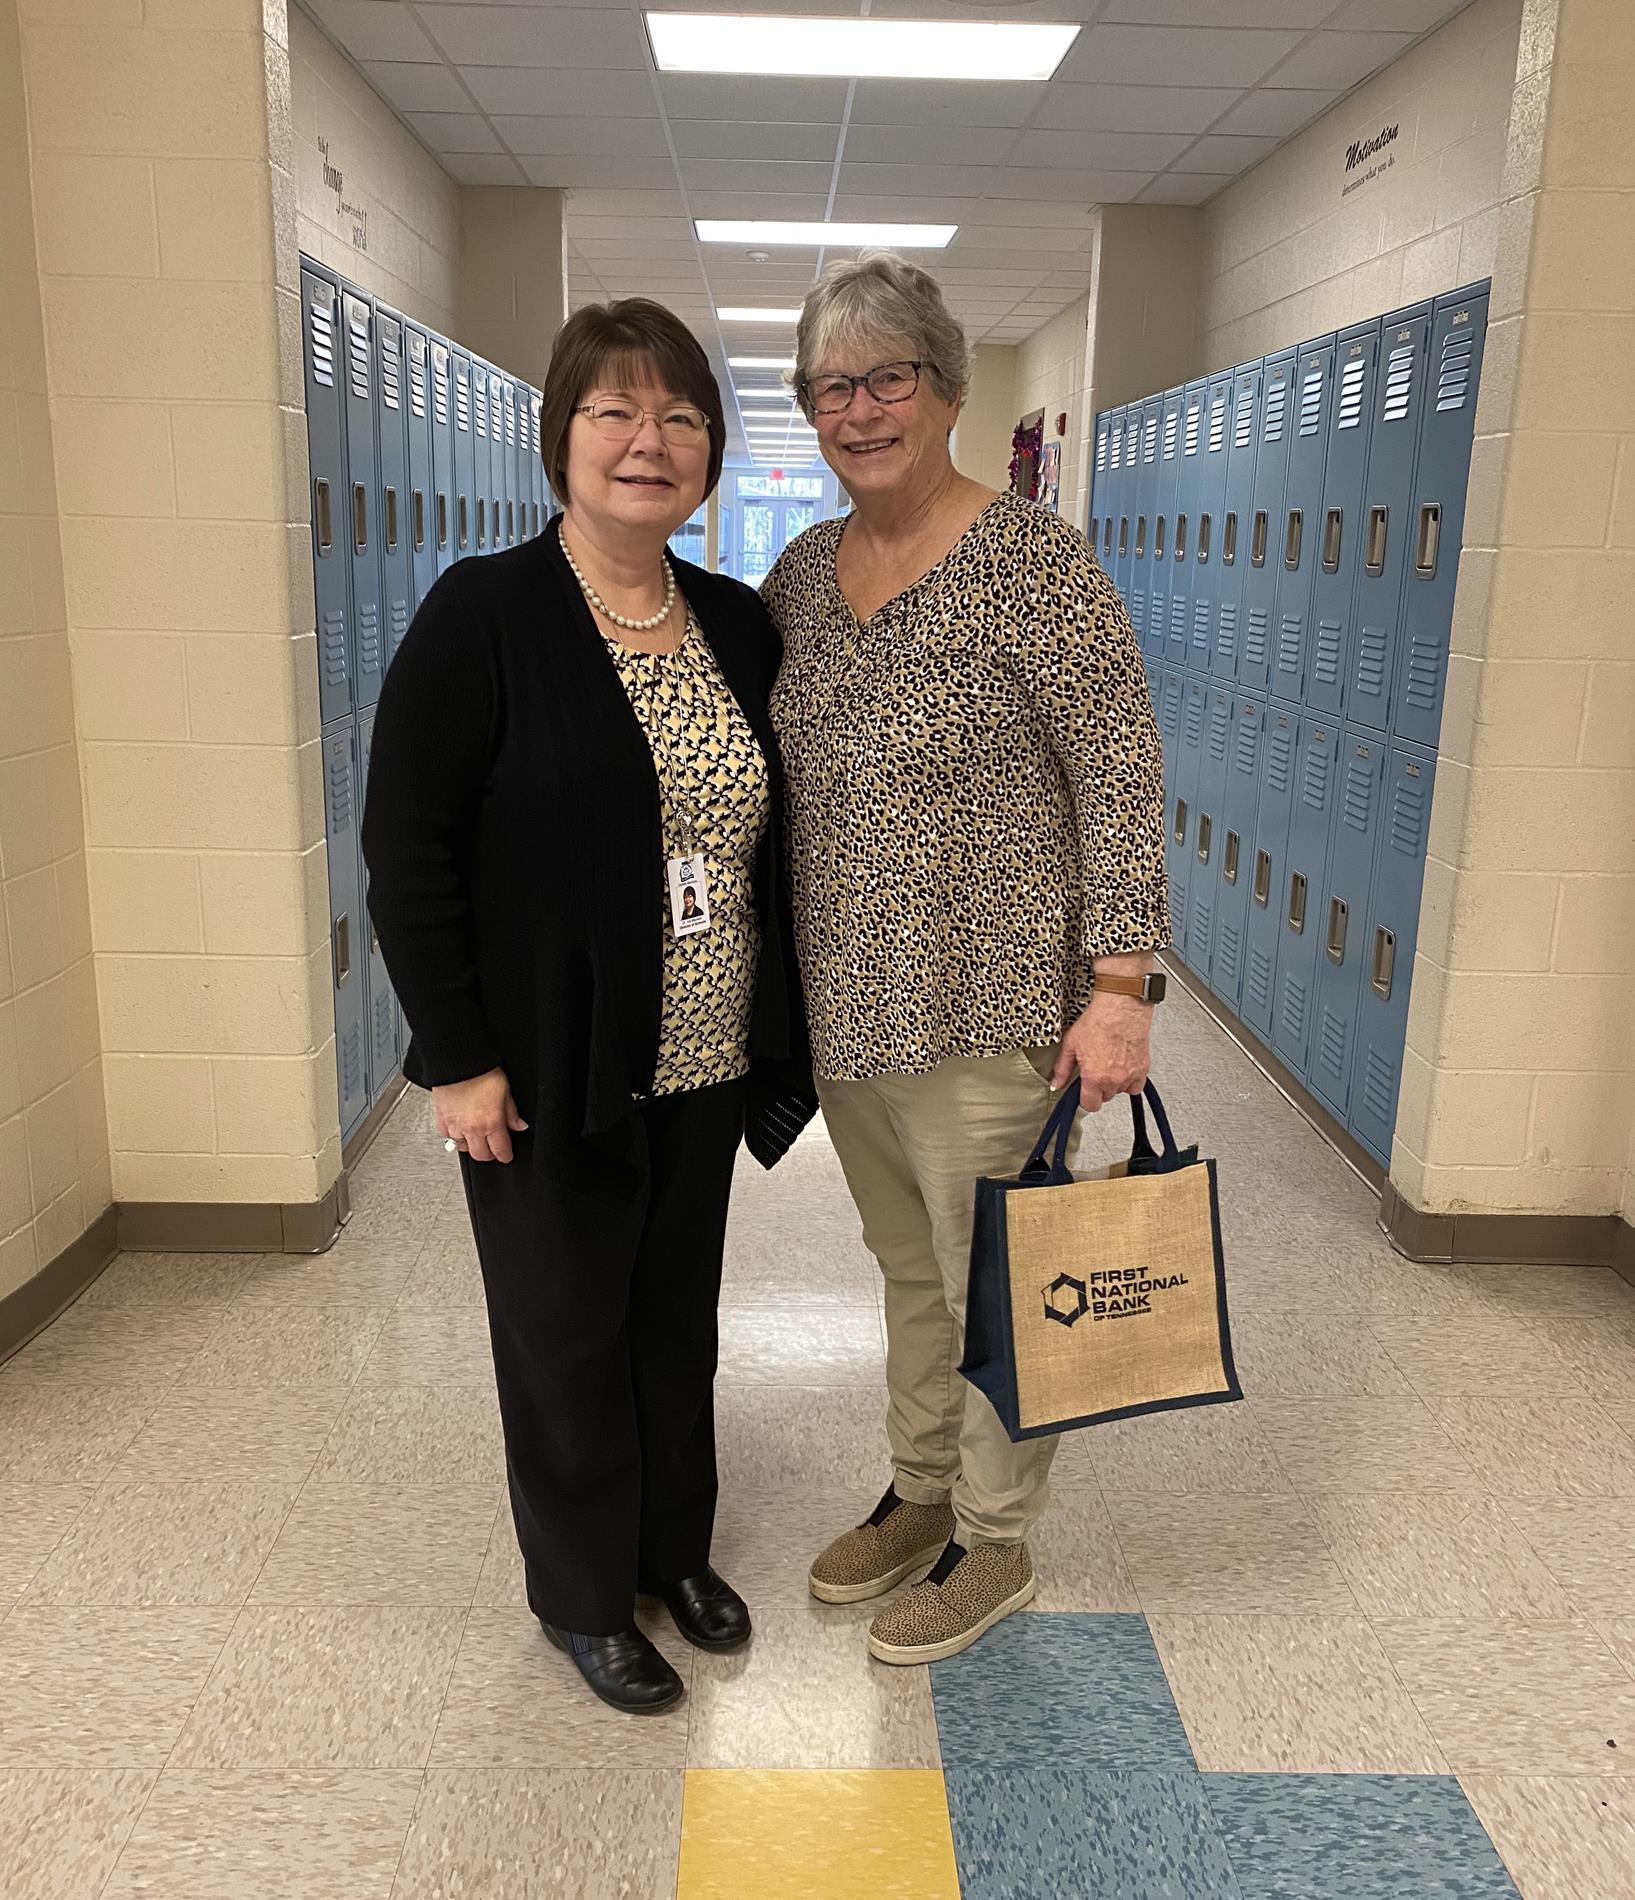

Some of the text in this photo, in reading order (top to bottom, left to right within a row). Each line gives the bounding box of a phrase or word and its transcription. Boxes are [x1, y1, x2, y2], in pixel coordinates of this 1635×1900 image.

[1345, 123, 1399, 173] Motivation
[1090, 1266, 1149, 1285] FIRST
[1091, 1273, 1189, 1300] NATIONAL
[1093, 1294, 1151, 1314] BANK
[1106, 1307, 1152, 1320] TENNESSEE
